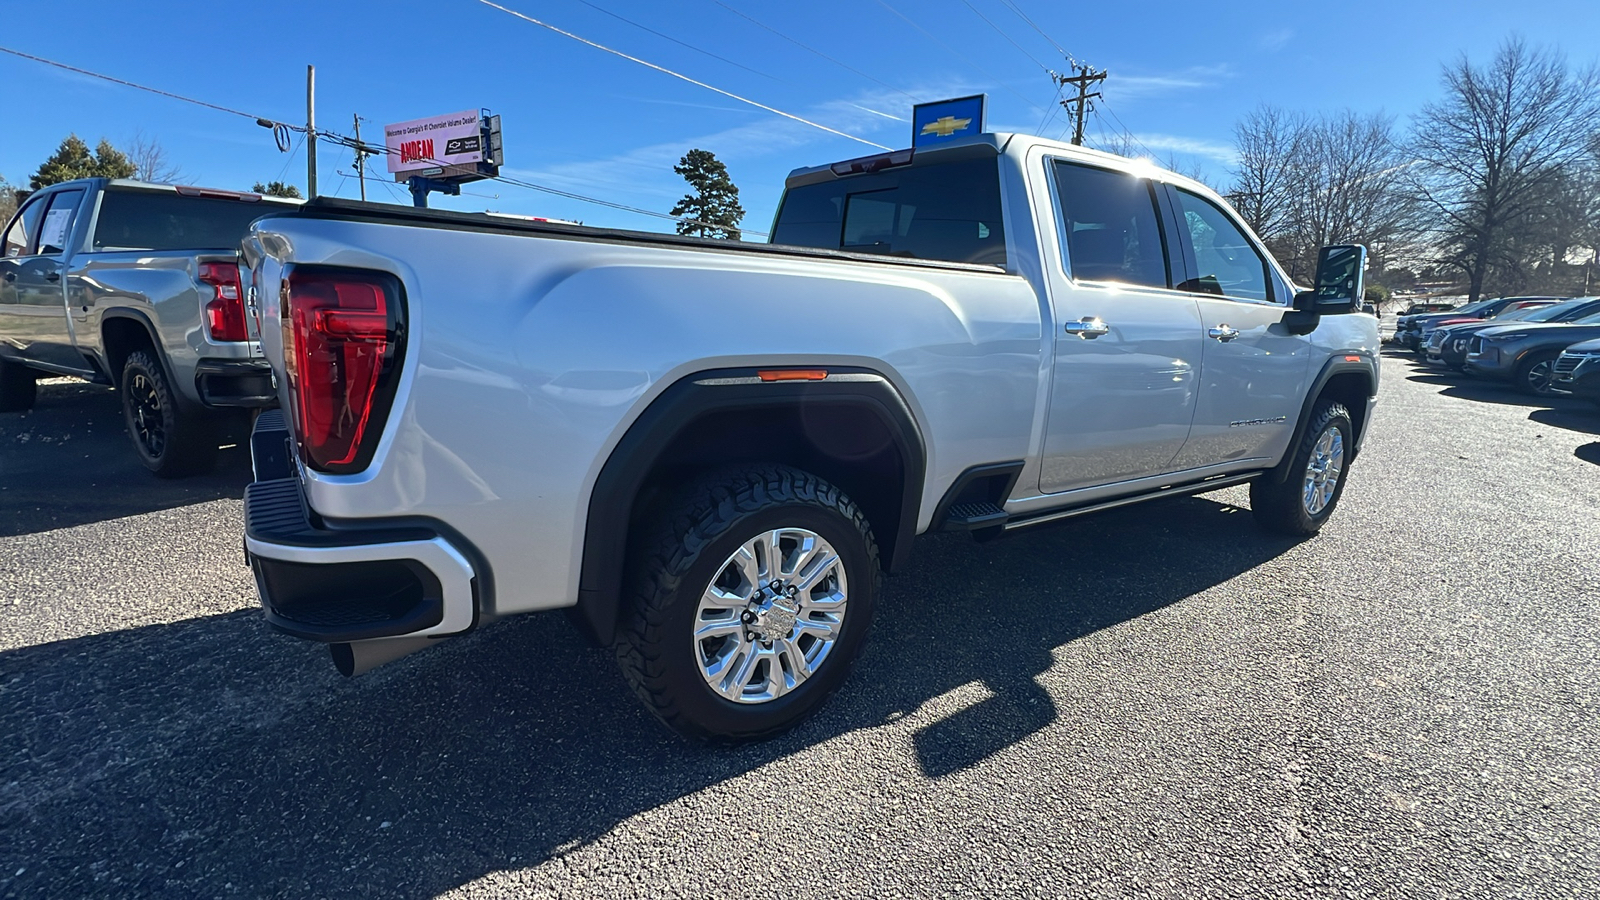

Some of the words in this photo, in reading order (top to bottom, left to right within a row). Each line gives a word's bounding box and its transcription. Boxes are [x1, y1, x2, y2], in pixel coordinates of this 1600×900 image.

[407, 125, 423, 135] Georgia's
[429, 122, 447, 130] Chevrolet
[400, 138, 434, 163] ANDEAN
